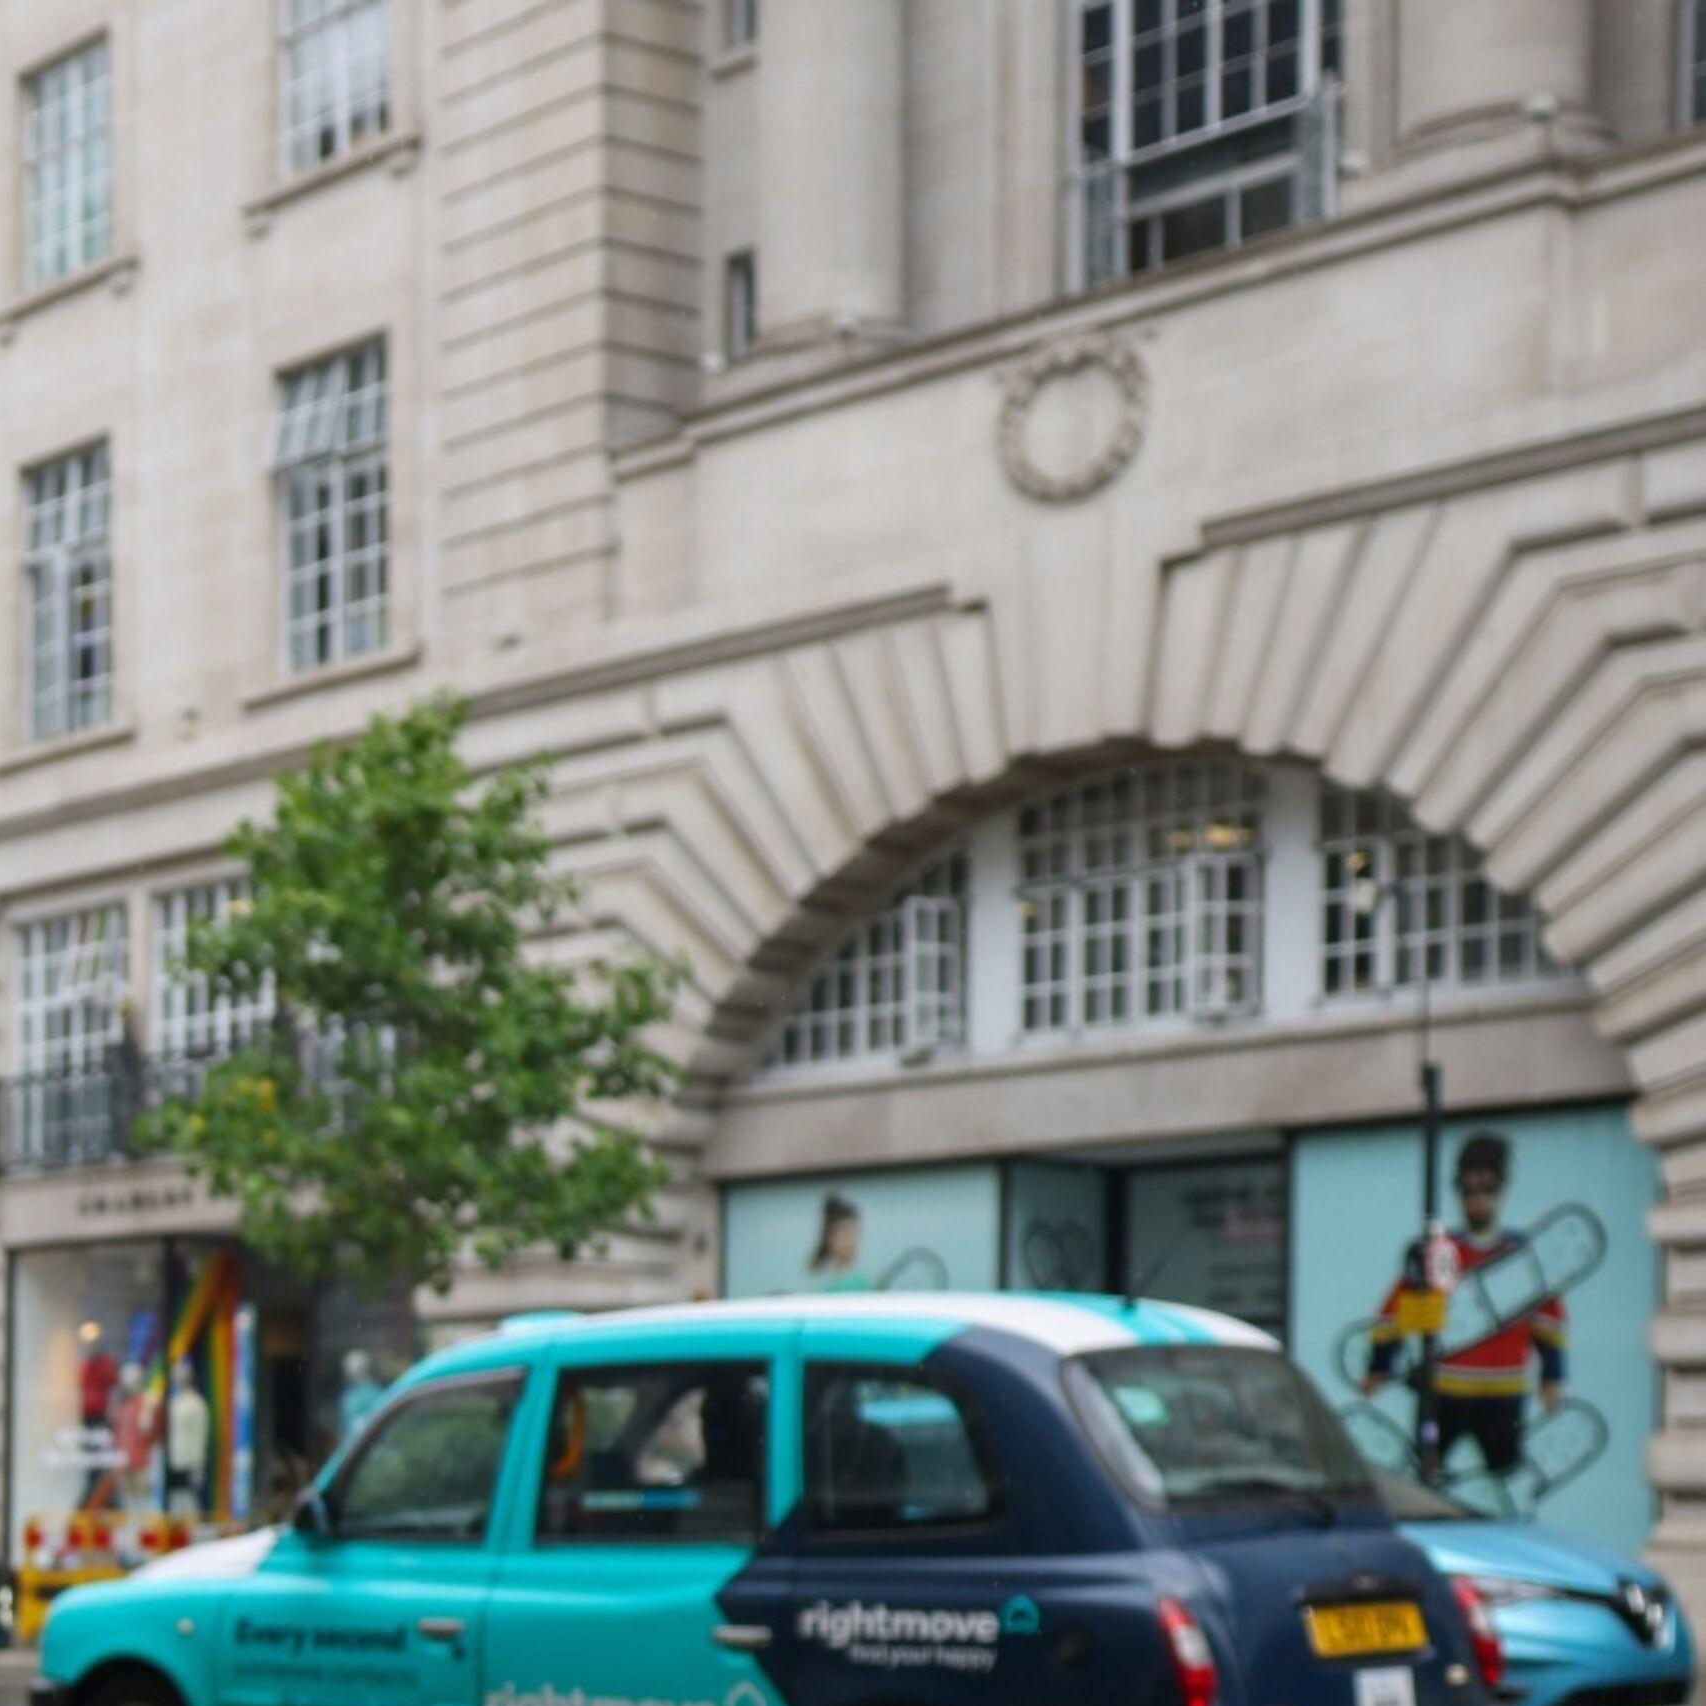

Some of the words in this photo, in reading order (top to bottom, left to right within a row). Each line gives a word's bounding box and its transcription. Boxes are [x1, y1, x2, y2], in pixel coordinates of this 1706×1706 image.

[235, 1619, 305, 1656] Every
[312, 1622, 407, 1653] second
[799, 1600, 1000, 1649] rightmove
